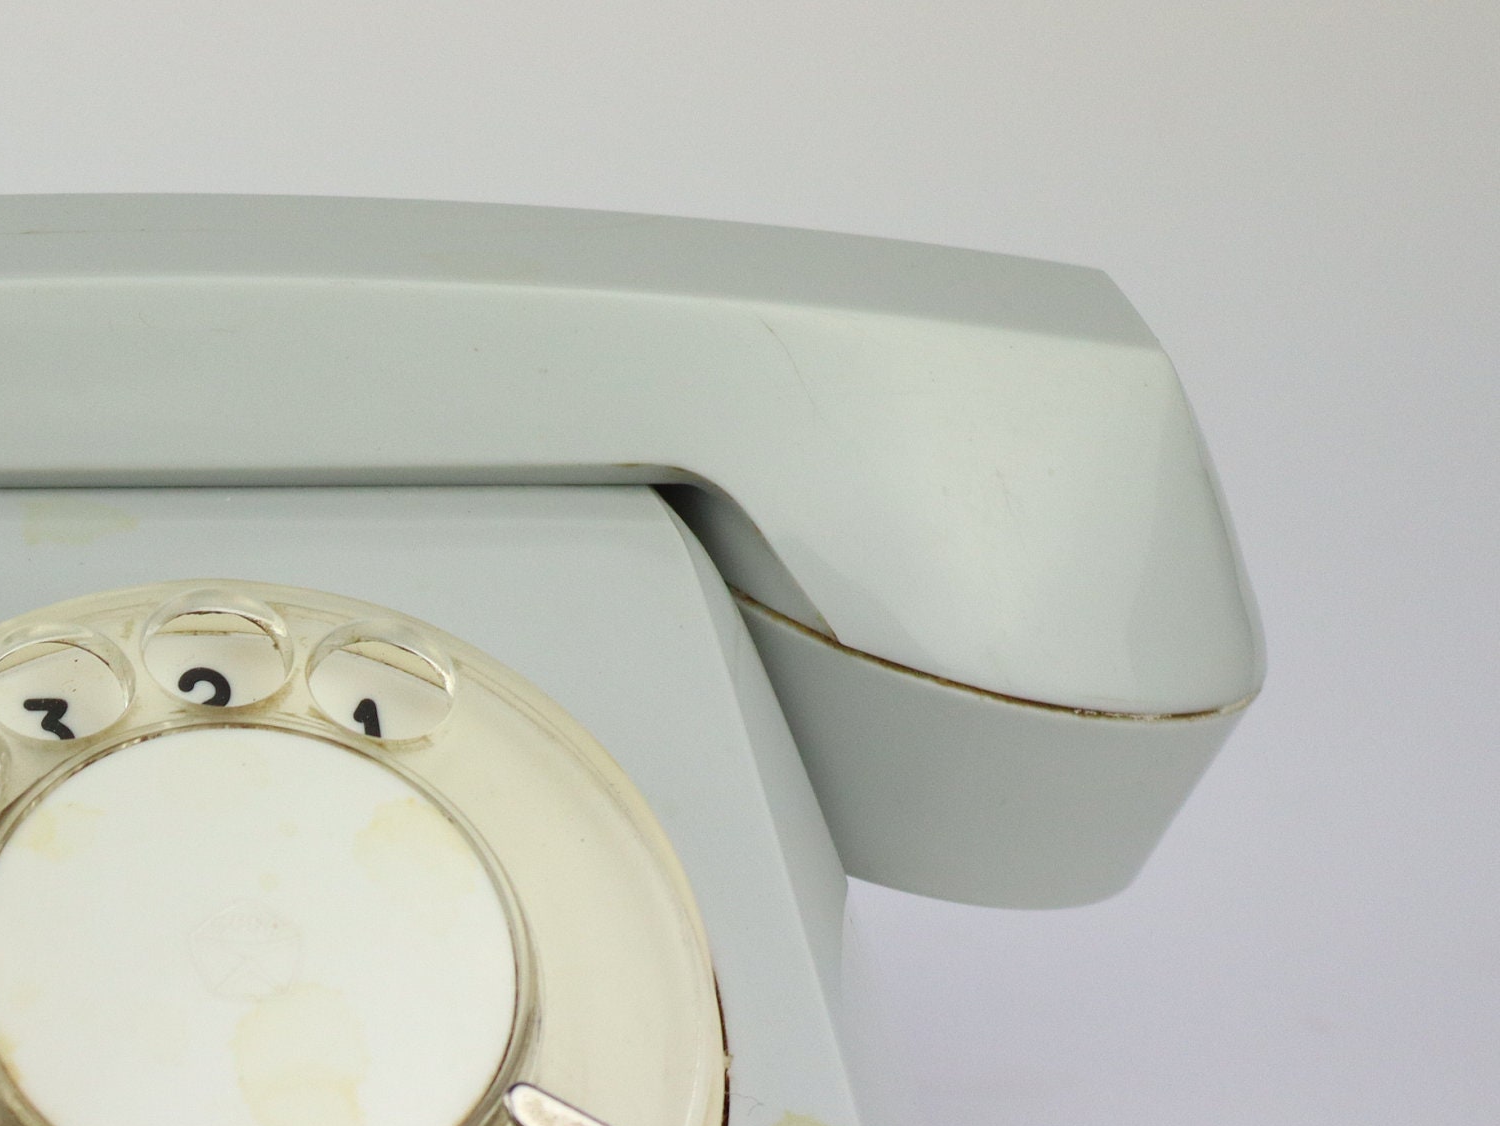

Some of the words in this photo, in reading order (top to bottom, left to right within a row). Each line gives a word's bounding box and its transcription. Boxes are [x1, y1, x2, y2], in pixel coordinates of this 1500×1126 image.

[178, 667, 232, 708] 2
[23, 698, 76, 741] 3
[353, 698, 382, 738] 1
